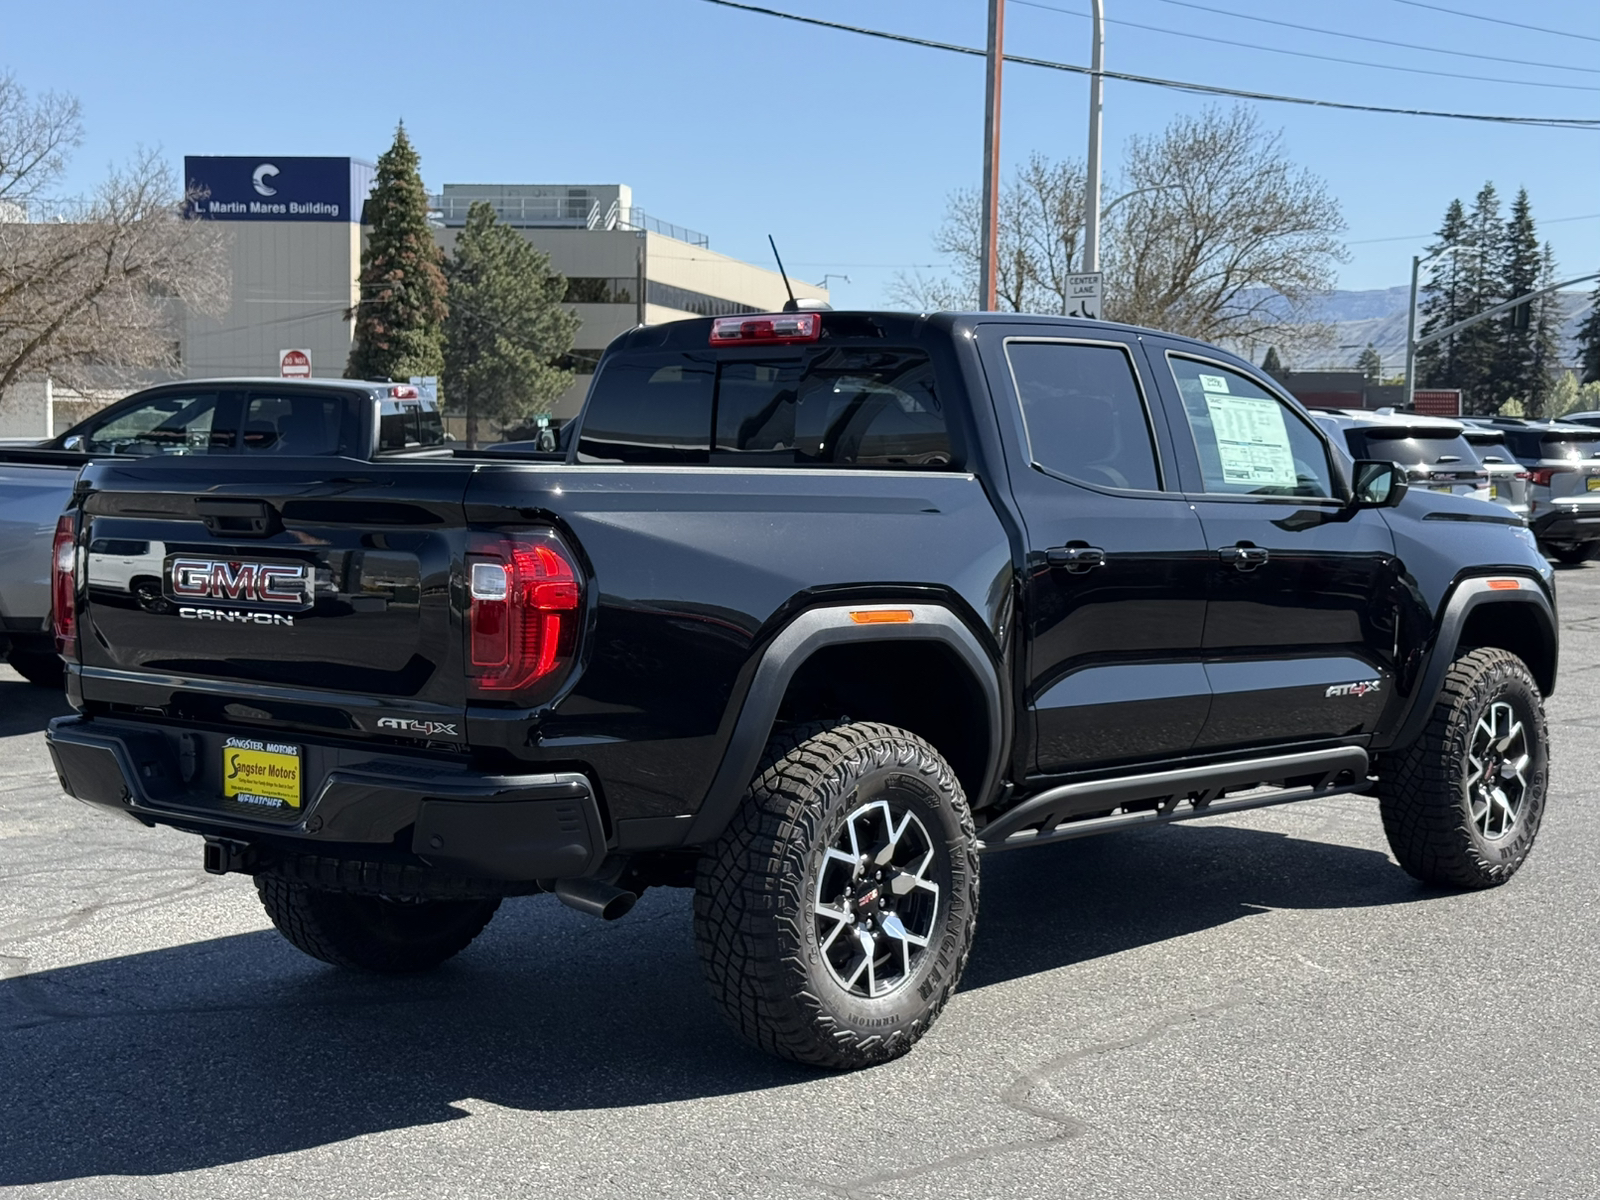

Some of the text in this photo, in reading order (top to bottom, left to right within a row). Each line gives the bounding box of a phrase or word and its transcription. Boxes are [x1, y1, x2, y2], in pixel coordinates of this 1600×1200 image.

[195, 201, 339, 216] L. Martin Mares Building
[1070, 276, 1098, 285] CENTER
[1074, 285, 1094, 294] LANE
[285, 357, 306, 365] DO NOT
[172, 558, 303, 604] GMC
[179, 607, 294, 626] CANYON
[1325, 680, 1381, 698] AT4X
[377, 717, 459, 736] AT4X
[221, 737, 298, 755] SANGSTER MOTORS
[227, 754, 297, 780] Sangster Motors
[917, 844, 965, 1002] WRANGLER
